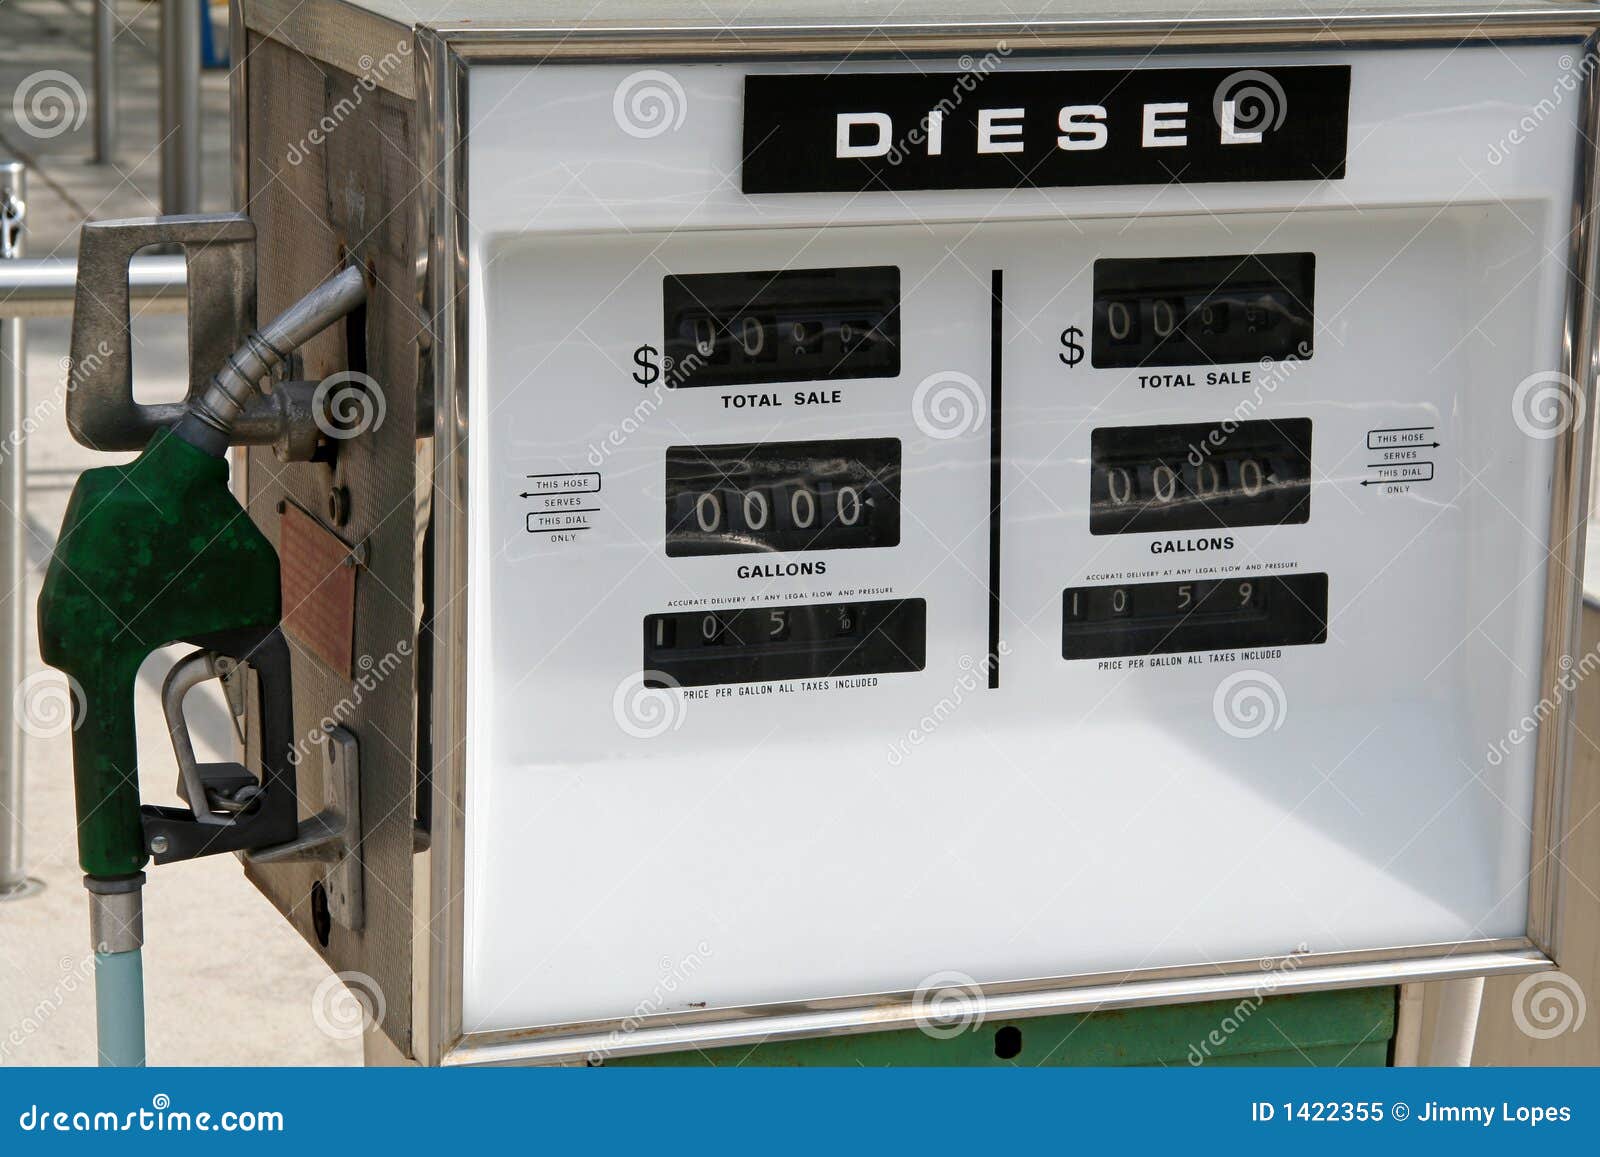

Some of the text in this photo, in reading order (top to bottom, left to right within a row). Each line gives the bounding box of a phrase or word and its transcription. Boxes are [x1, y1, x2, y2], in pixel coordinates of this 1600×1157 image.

[836, 101, 1263, 158] DIESEL
[1059, 326, 1085, 368] $
[632, 344, 660, 388] $
[1139, 371, 1251, 389] TOTAL SALE
[721, 391, 842, 409] TOTAL SALE
[1378, 433, 1424, 443] THIS HOSE
[1384, 451, 1417, 460] SERVES
[1403, 468, 1422, 476] DIAL
[536, 479, 588, 489] THIS HOSE
[1388, 486, 1410, 494] ONLY
[544, 498, 581, 507] SERVES
[539, 516, 588, 525] THIS DIAL
[551, 534, 576, 542] ONLY
[1151, 537, 1234, 554] GALLONS
[737, 562, 826, 579] GALLONS
[1086, 572, 1122, 580] ACCURATE
[668, 598, 707, 607] ACCURATE
[711, 596, 745, 604] DELIVERY
[859, 587, 893, 595] PRESSURE
[1098, 650, 1281, 670] PRICE PER GALLON ALL TAXES INCLUDED
[684, 678, 878, 700] PRICE PER GALLON ALL TAXES INCLUDED
